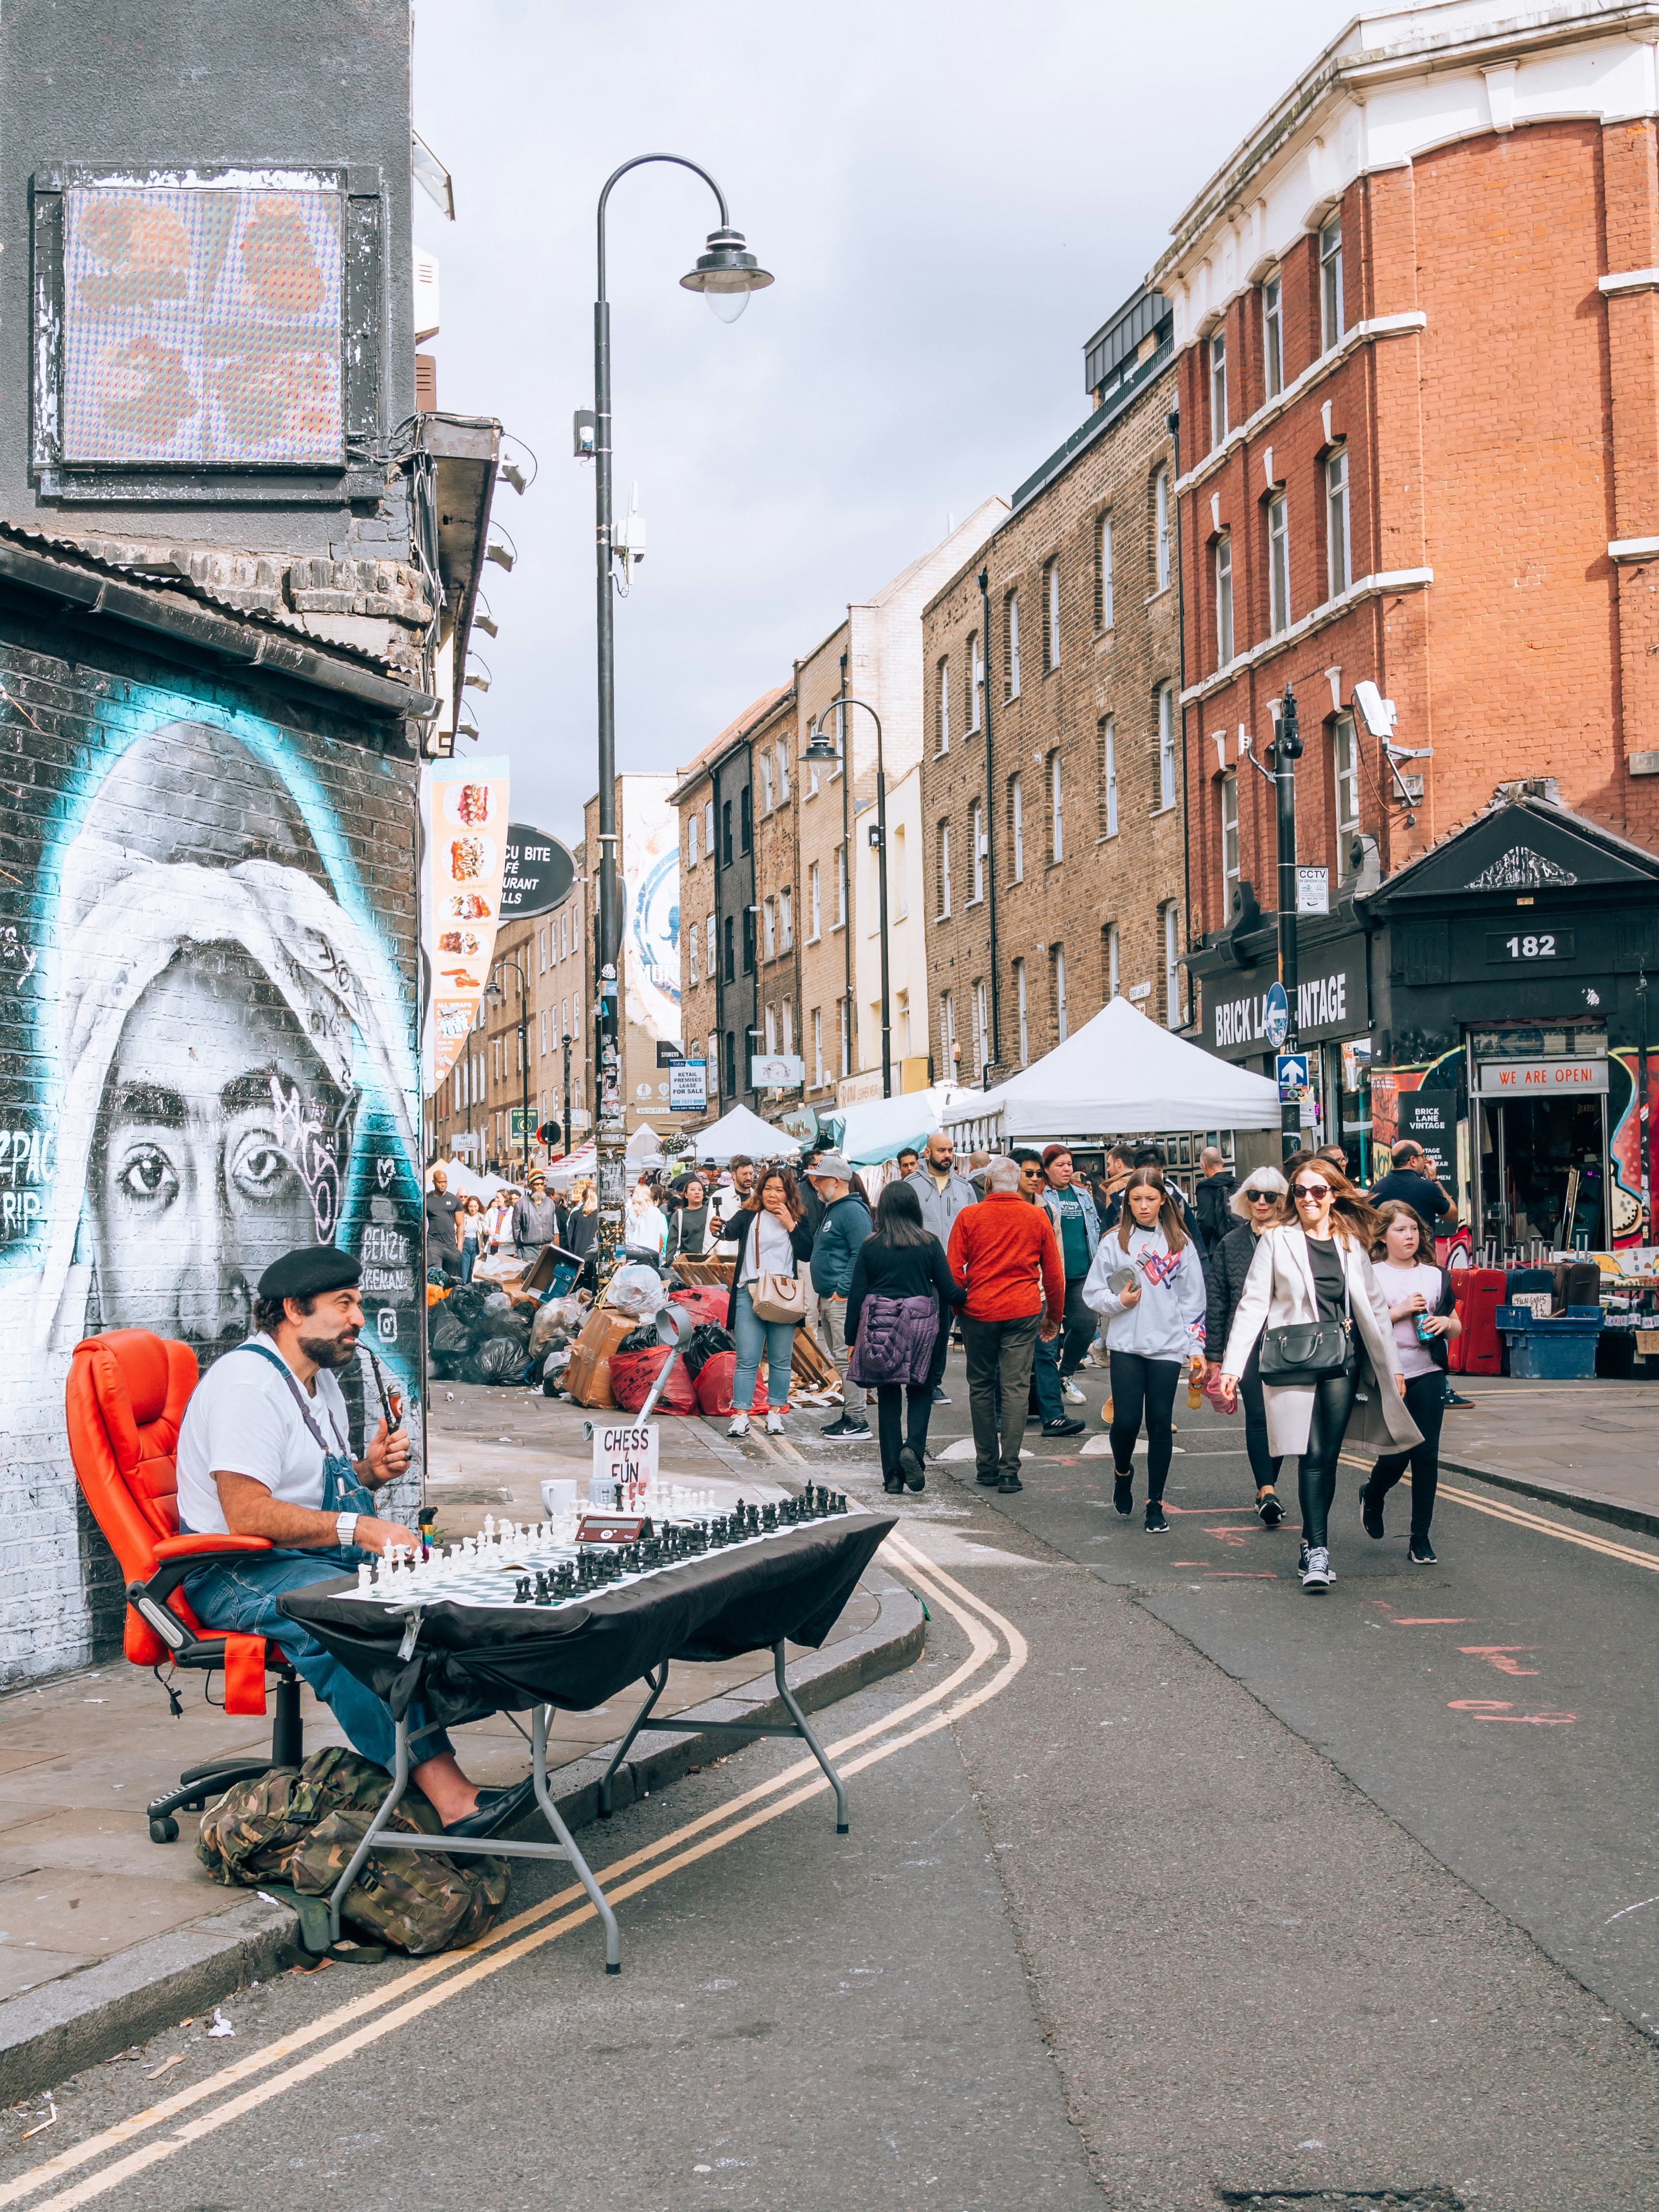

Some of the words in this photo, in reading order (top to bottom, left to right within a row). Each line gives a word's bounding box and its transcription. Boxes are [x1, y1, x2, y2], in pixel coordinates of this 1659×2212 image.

[455, 762, 488, 776] WRAPS
[524, 846, 551, 861] BITE
[505, 860, 519, 874] FÉ
[1506, 936, 1555, 957] 182
[637, 964, 680, 982] MOR
[1216, 998, 1251, 1047] BRICK
[1254, 994, 1269, 1039] LA
[1298, 973, 1346, 1029] INTAGE
[1499, 1071, 1516, 1085] WE
[1525, 1070, 1547, 1083] ARE
[1555, 1068, 1592, 1082] OPEN!
[2, 1192, 40, 1234] RIP
[1529, 1295, 1547, 1304] SNAPS
[604, 1428, 648, 1452] CHESS
[625, 1451, 629, 1463] 4
[612, 1462, 639, 1483] FUN
